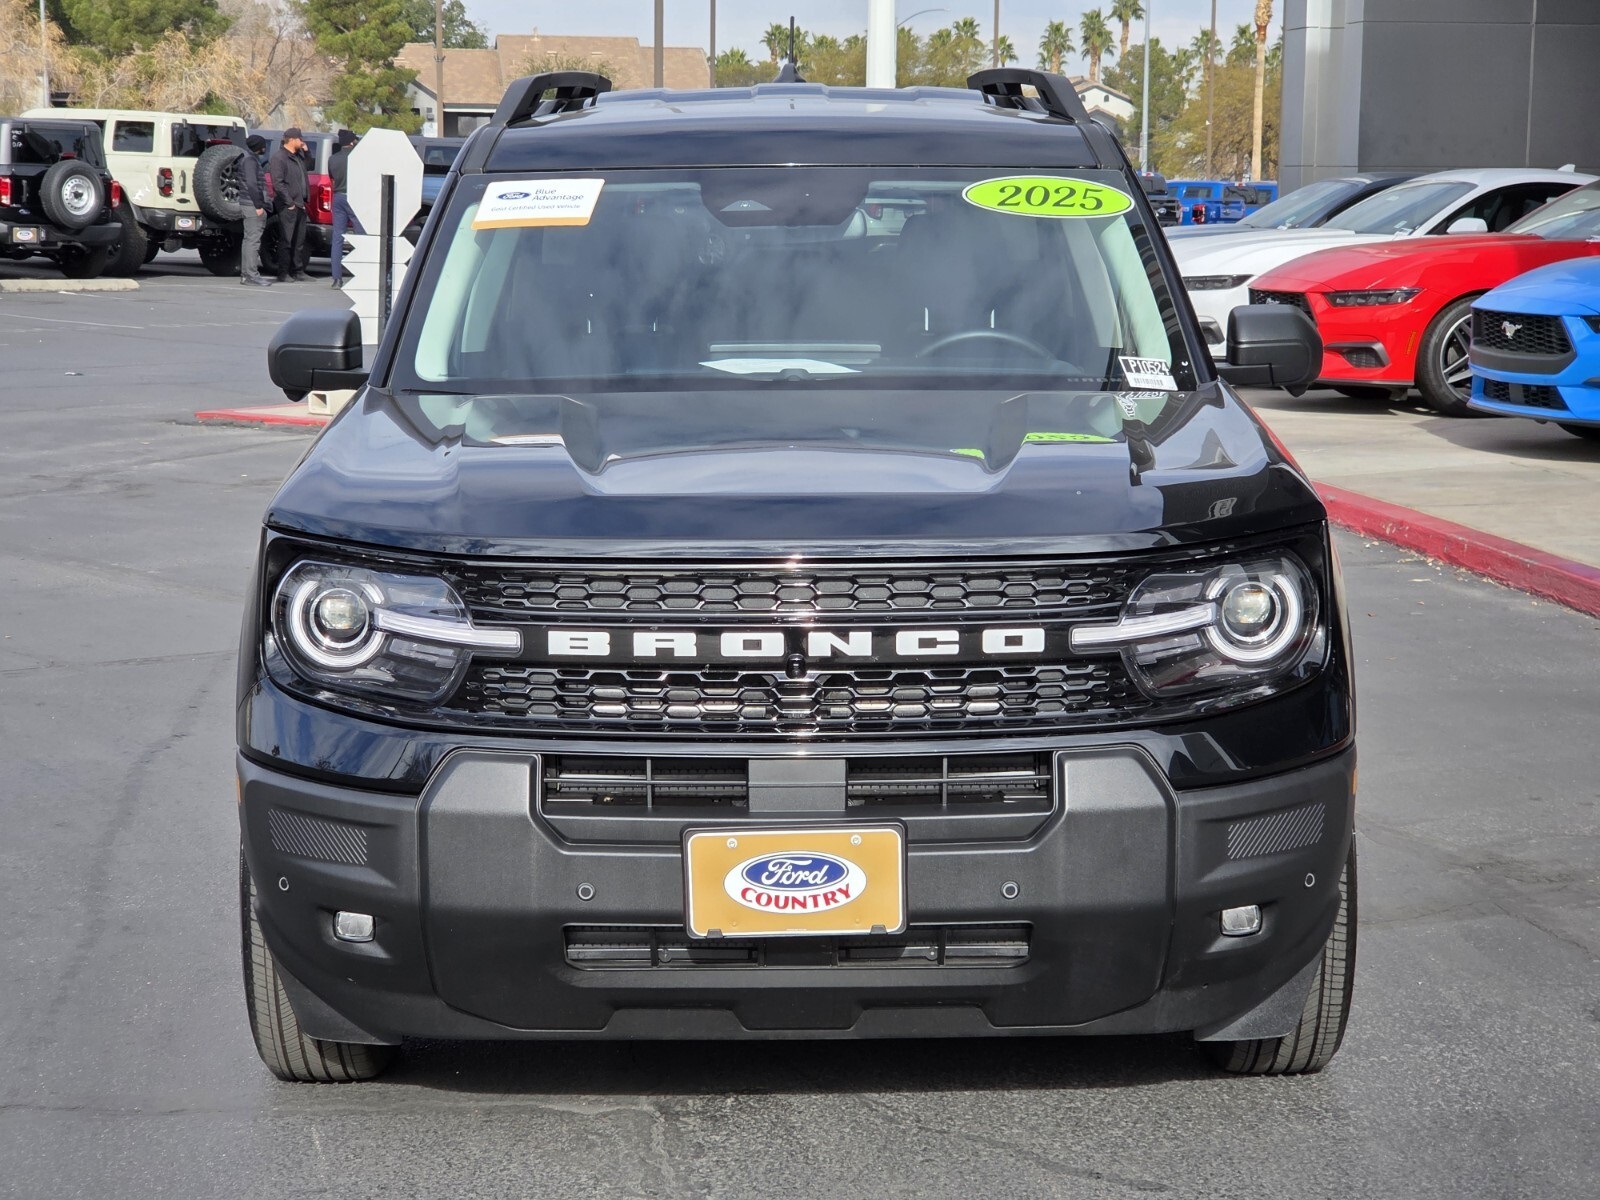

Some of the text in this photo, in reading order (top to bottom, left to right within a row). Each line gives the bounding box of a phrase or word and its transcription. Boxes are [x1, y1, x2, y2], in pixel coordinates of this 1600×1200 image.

[997, 185, 1103, 210] 2025
[1128, 360, 1169, 376] P10524
[548, 628, 1045, 657] BRONCO
[761, 859, 829, 885] Ford
[741, 883, 850, 910] COUNTRY
